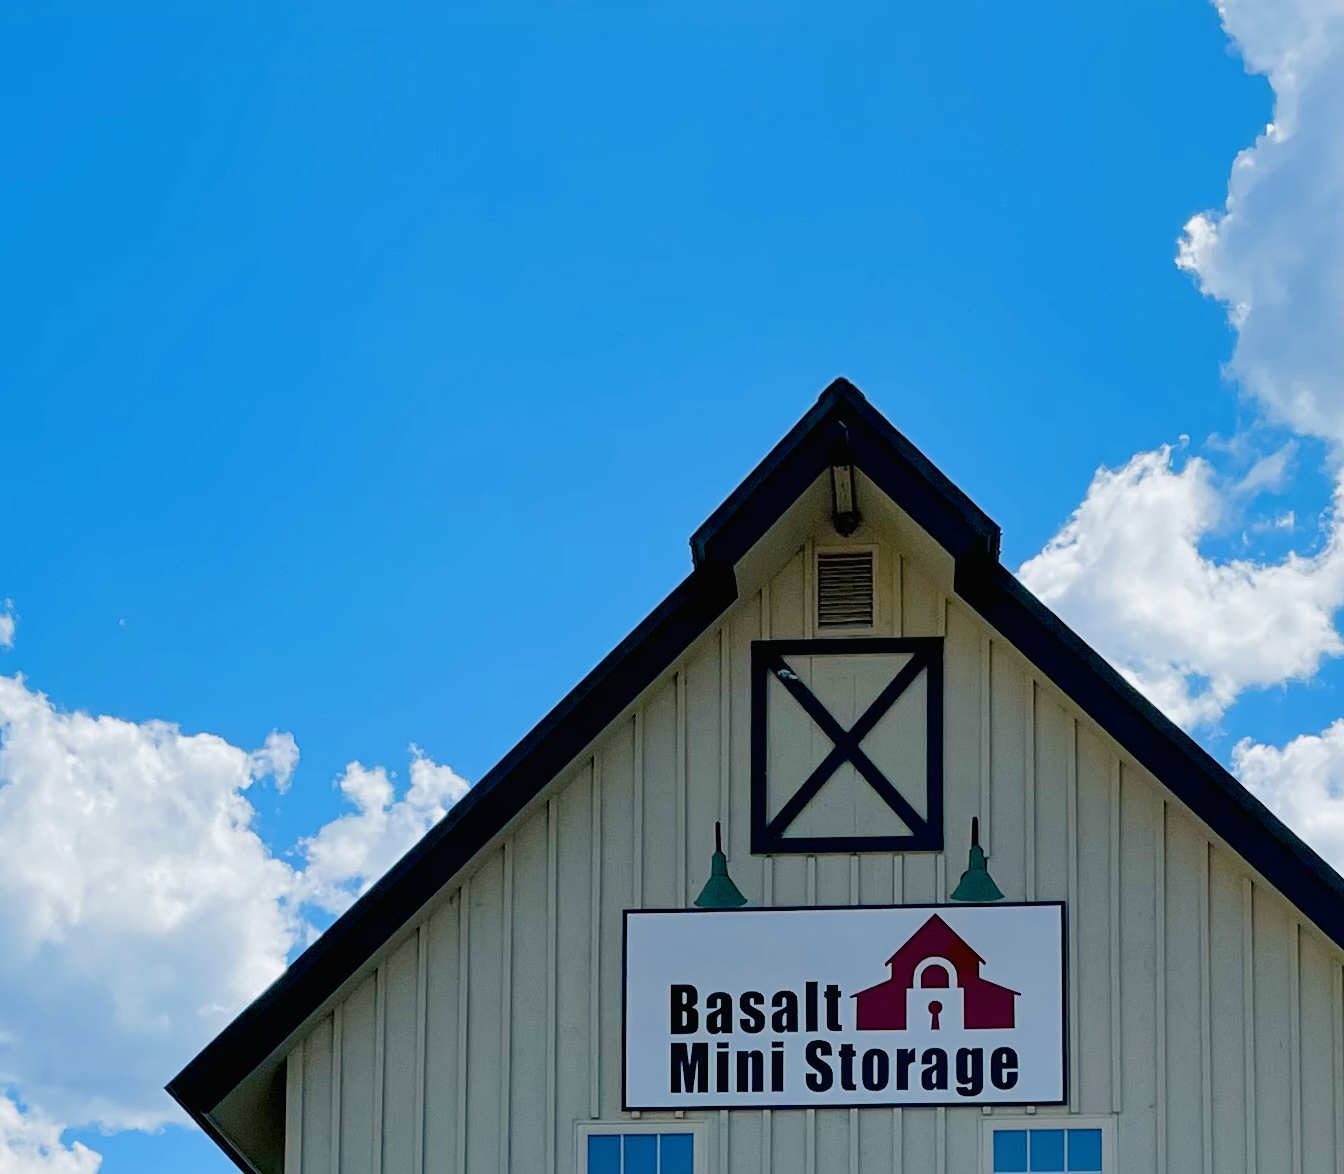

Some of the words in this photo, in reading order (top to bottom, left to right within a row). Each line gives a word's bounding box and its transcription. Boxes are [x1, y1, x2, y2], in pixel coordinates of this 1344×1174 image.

[670, 981, 843, 1035] Basalt
[670, 1041, 785, 1093] Mini
[805, 1039, 1019, 1097] Storage
